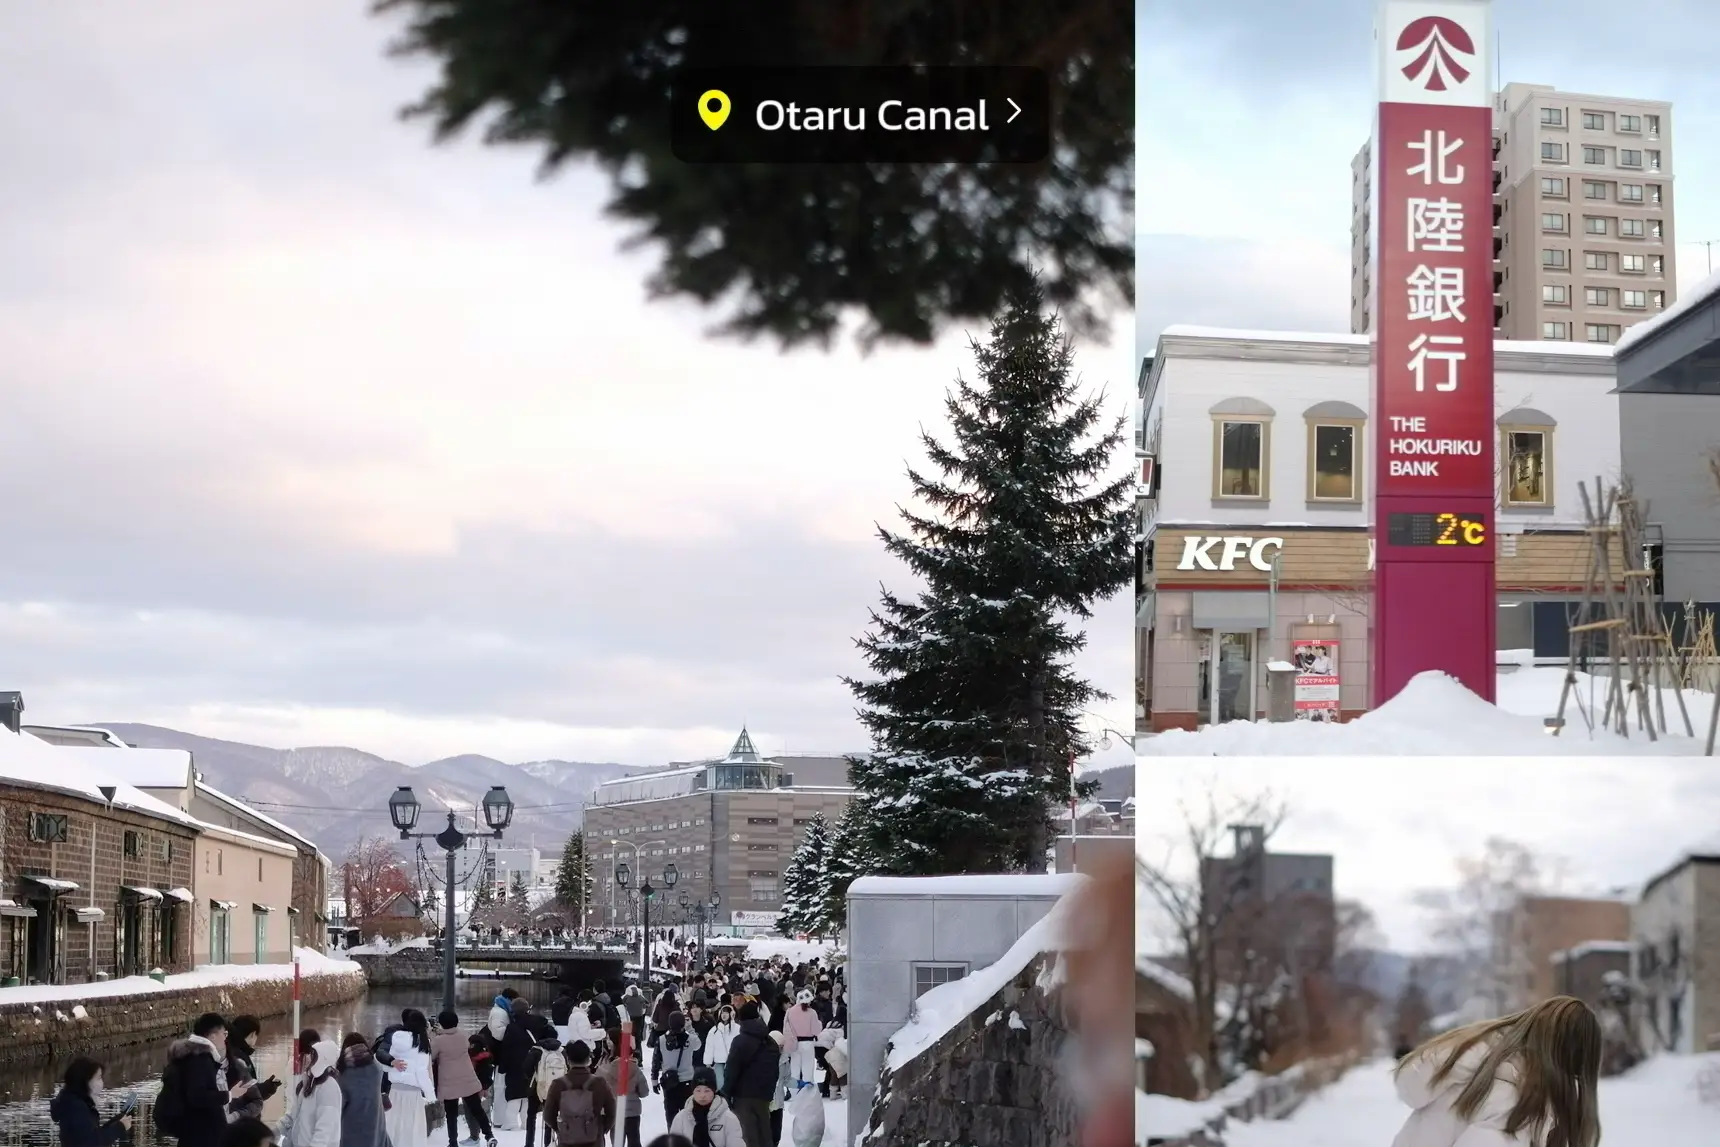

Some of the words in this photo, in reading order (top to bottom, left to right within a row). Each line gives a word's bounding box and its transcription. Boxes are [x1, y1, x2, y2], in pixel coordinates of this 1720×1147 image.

[1406, 129, 1466, 392] 北陸銀行
[1389, 416, 1426, 433] THE
[1389, 438, 1481, 455] HOKURIKU
[1389, 460, 1439, 477] BANK
[1177, 536, 1284, 571] KFC
